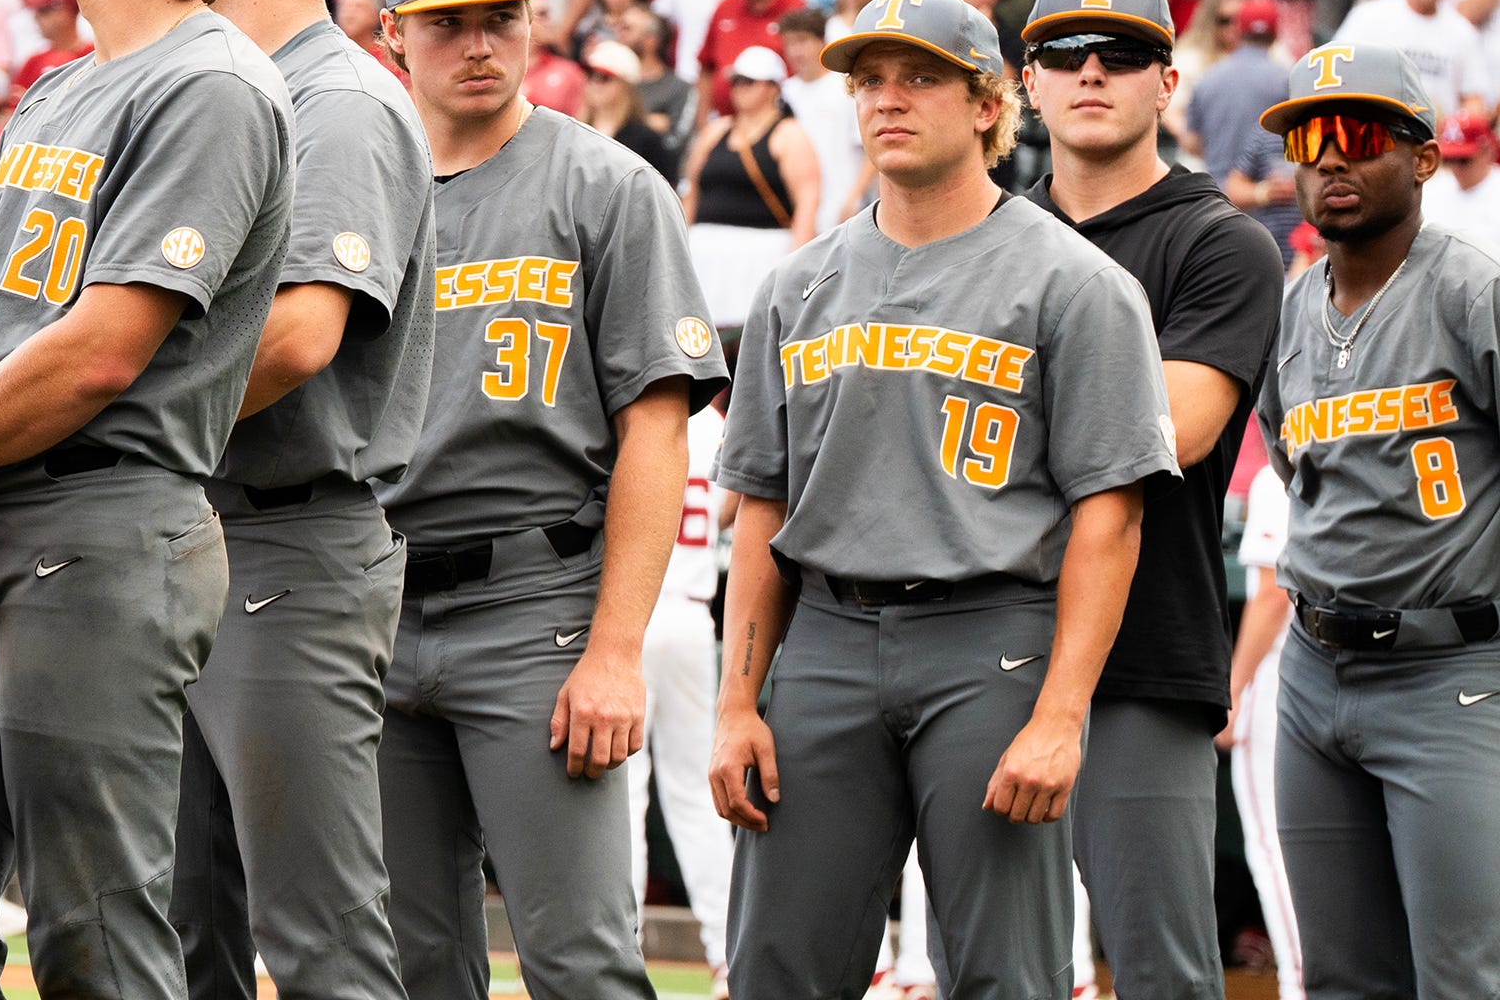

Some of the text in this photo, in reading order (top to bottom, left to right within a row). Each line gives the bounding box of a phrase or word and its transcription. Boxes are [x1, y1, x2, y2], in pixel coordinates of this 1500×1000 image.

[1308, 46, 1355, 90] T
[0, 207, 88, 306] 20
[163, 230, 203, 267] SEC
[335, 236, 368, 270] SEC
[481, 317, 572, 408] 37
[677, 320, 709, 355] SEC
[780, 322, 1036, 393] TENNESSEE
[940, 395, 1021, 490] 19
[1411, 436, 1467, 520] 8
